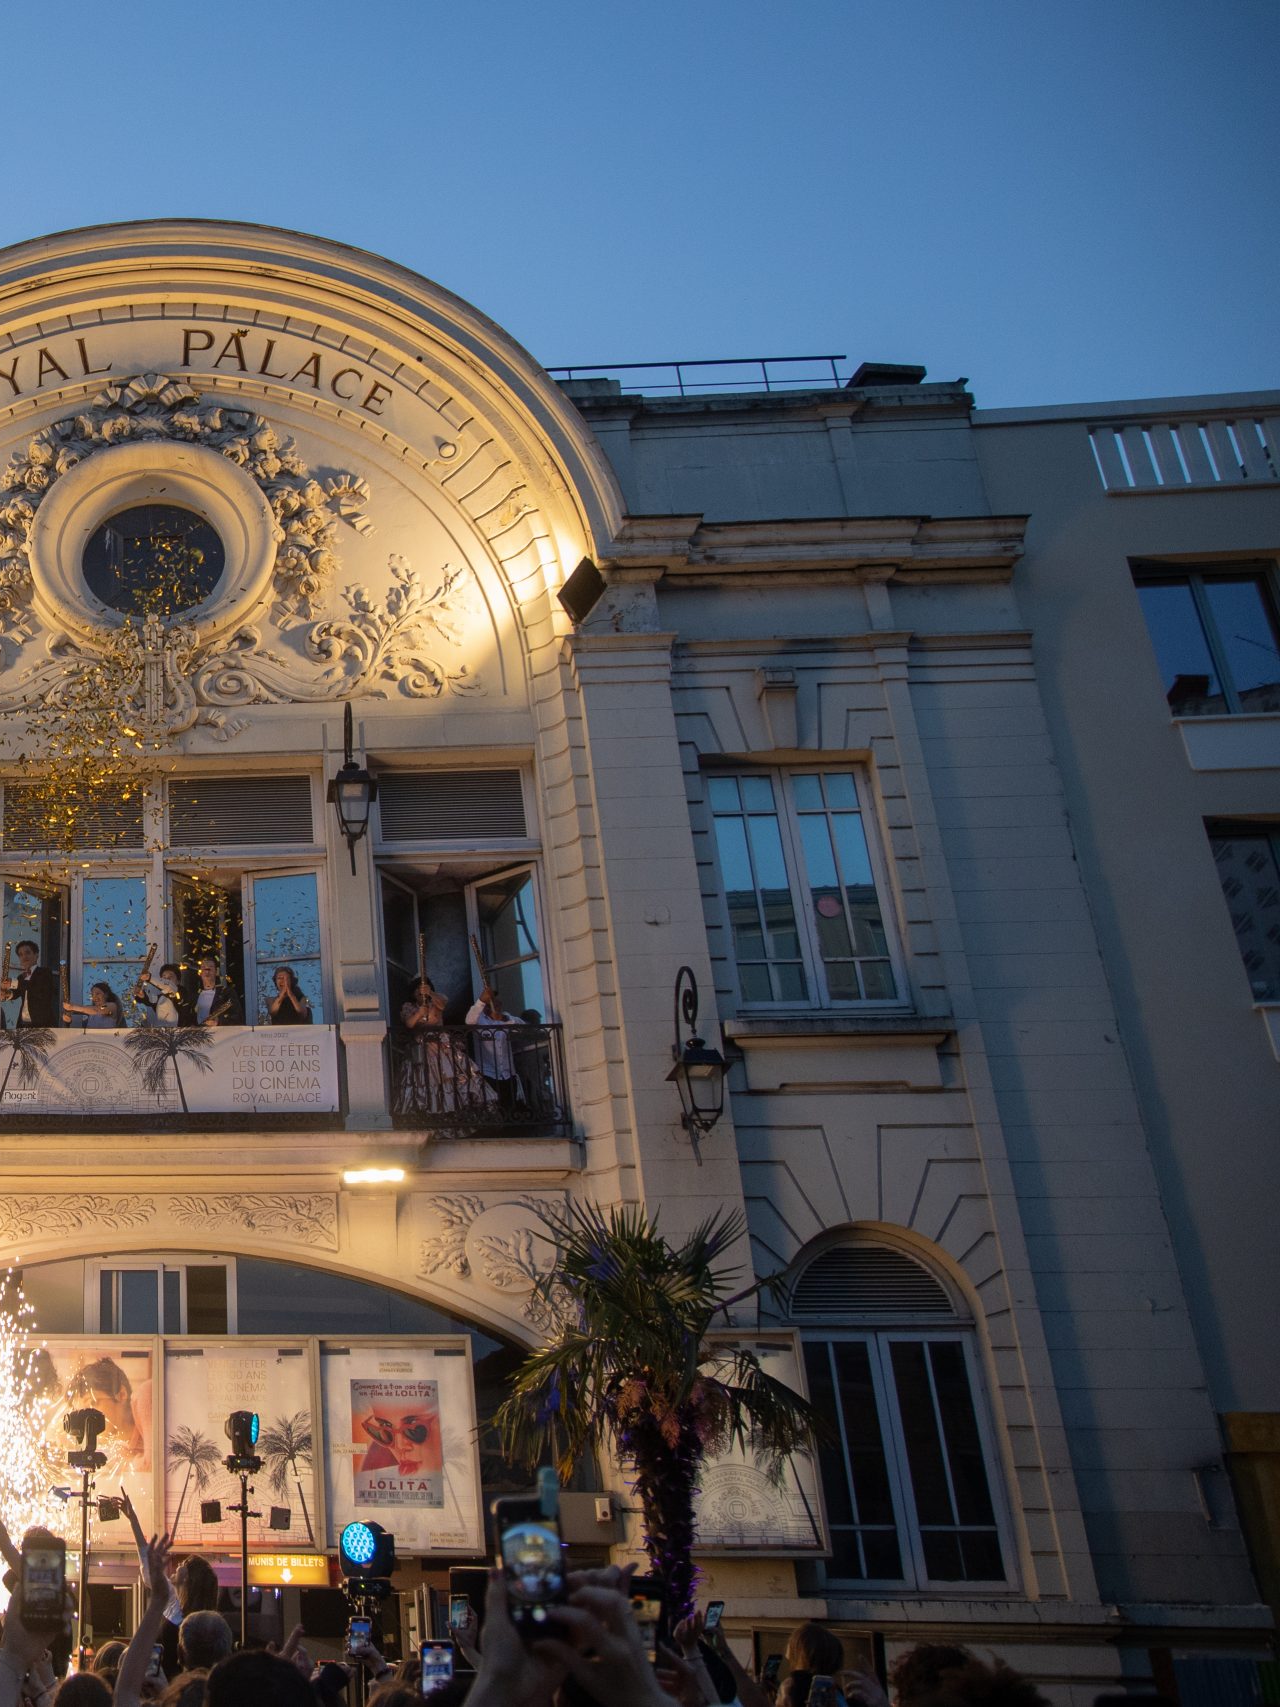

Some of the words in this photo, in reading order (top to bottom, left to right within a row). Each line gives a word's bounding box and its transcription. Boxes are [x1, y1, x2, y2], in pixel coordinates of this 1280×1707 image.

[180, 328, 393, 416] PALACE
[232, 1045, 276, 1057] VENEZ
[280, 1042, 320, 1056] FÊTER
[232, 1060, 256, 1072] LES
[261, 1060, 284, 1072] 100
[290, 1060, 320, 1072] ANS
[232, 1077, 254, 1090] DU
[260, 1074, 320, 1090] CINÉMA
[232, 1092, 272, 1103] ROYAL
[276, 1092, 320, 1103] PALACE
[370, 1480, 428, 1491] LOLITA
[248, 1557, 274, 1566] MUNIS
[276, 1558, 288, 1567] DE
[291, 1558, 324, 1567] BILLETS
